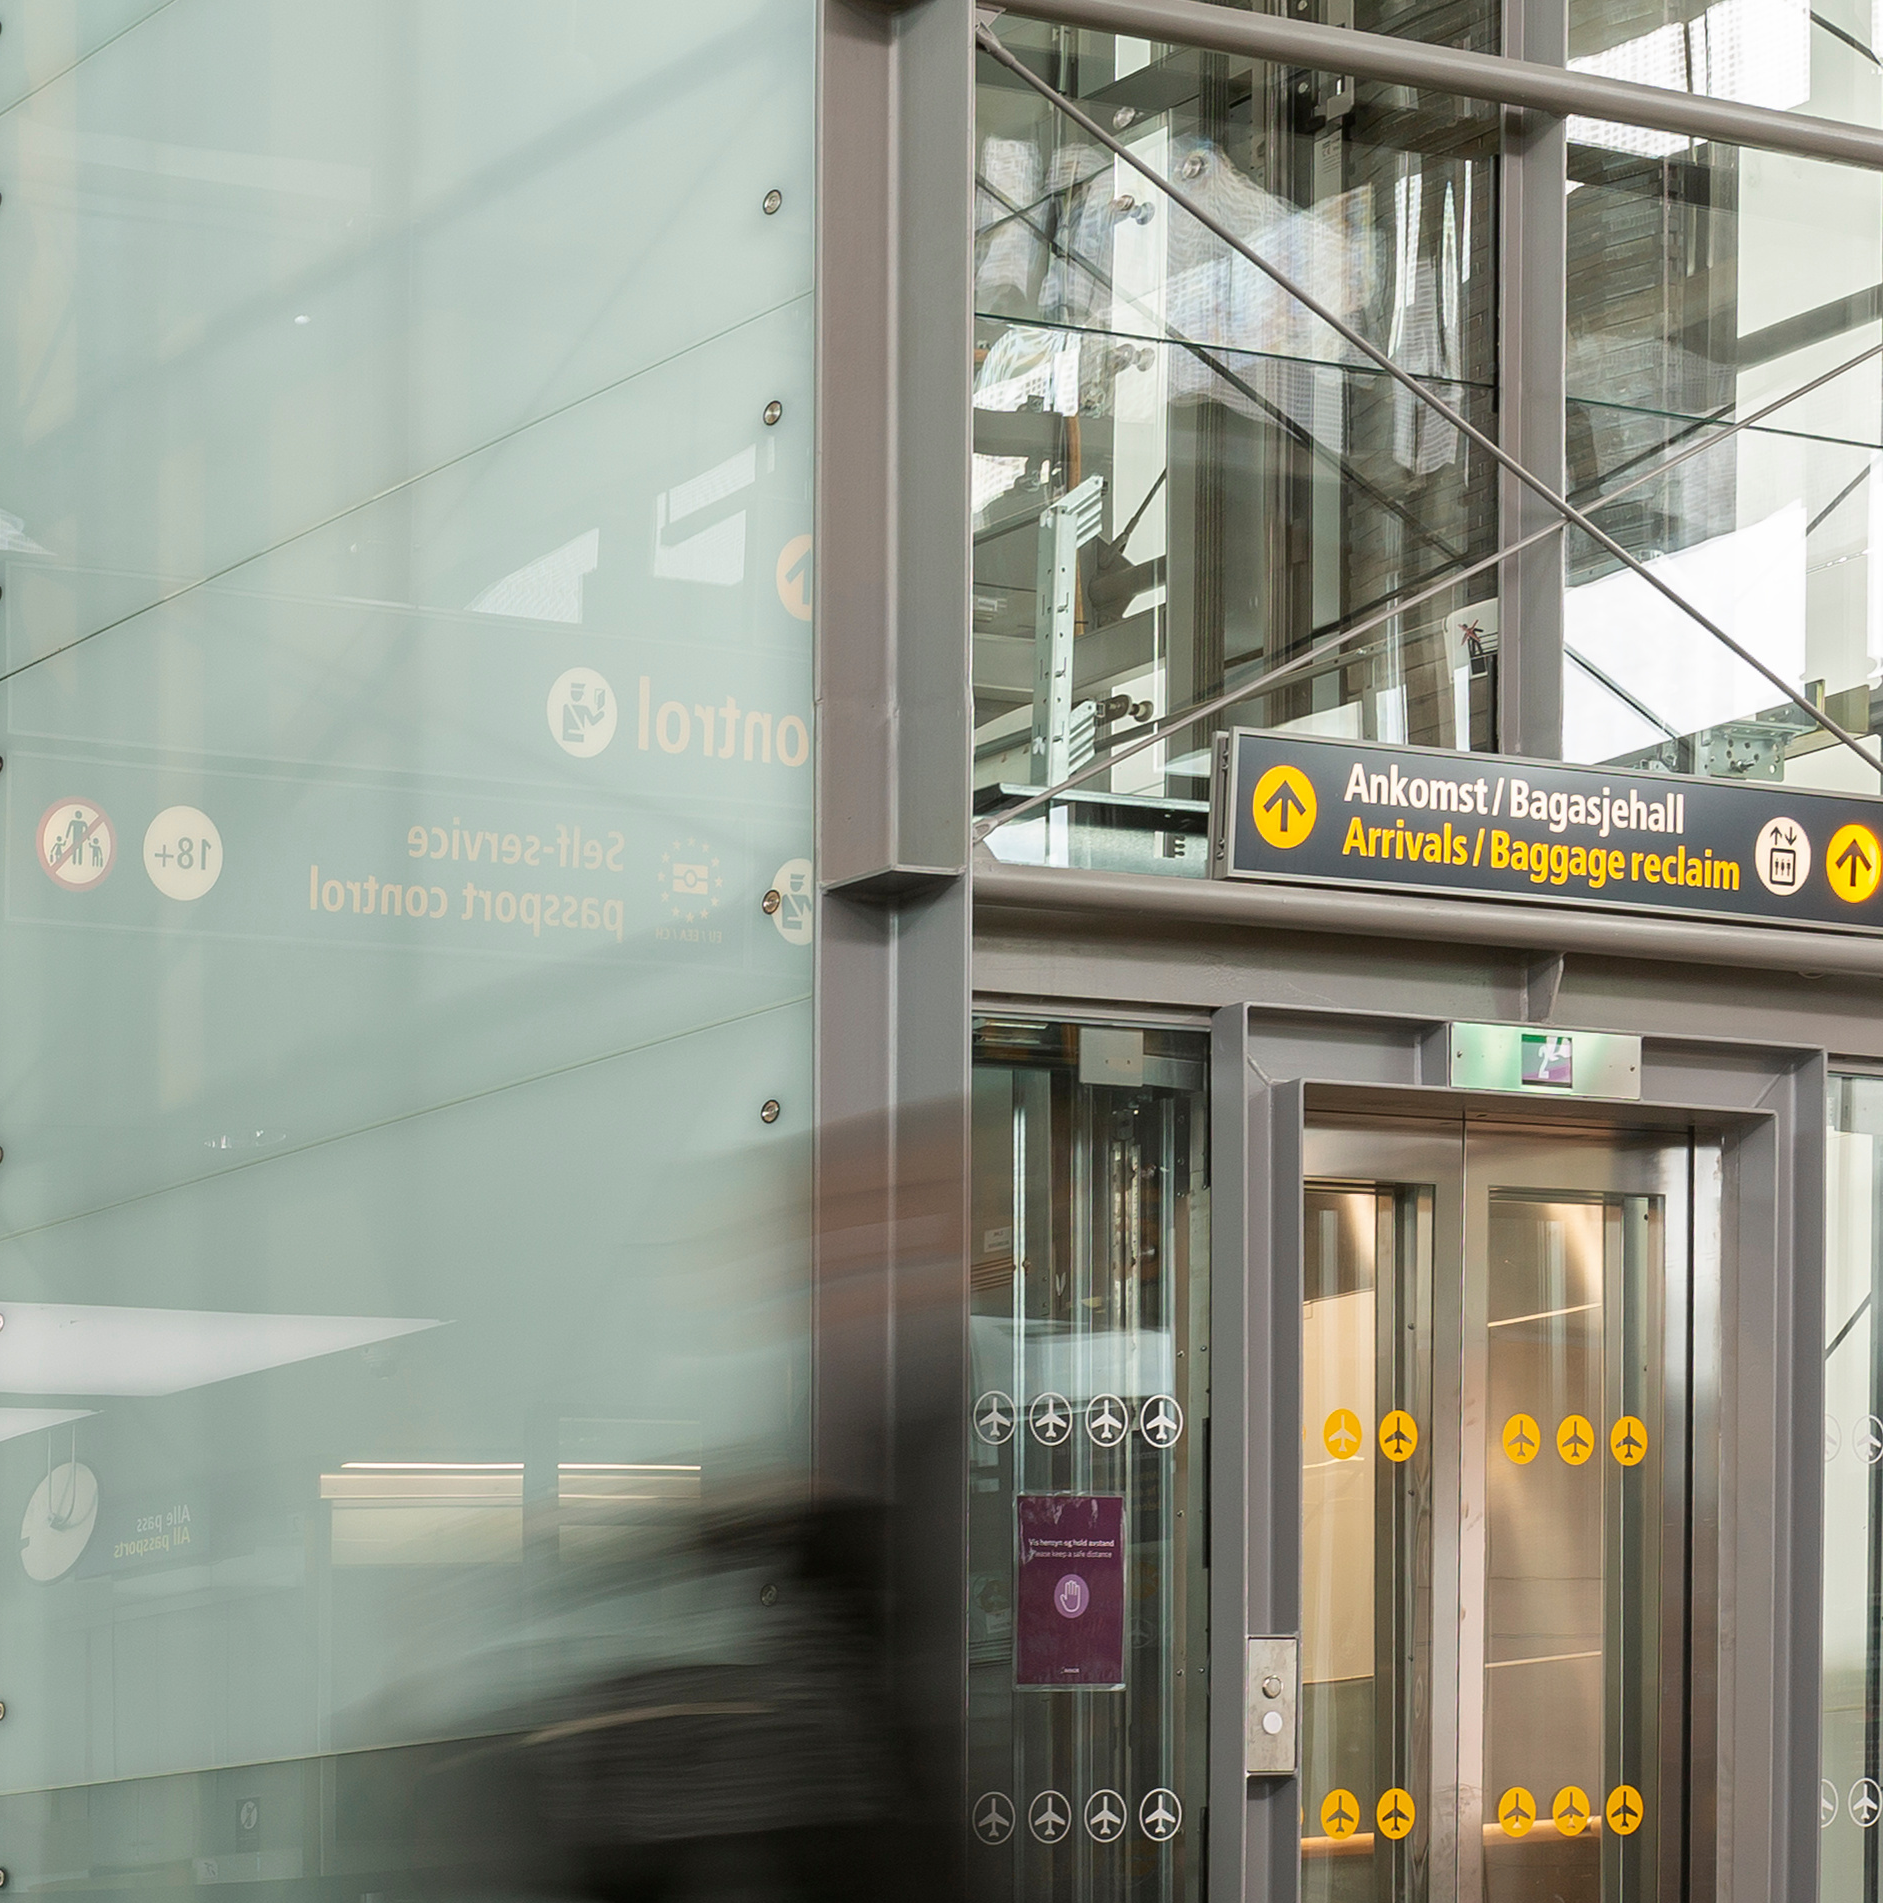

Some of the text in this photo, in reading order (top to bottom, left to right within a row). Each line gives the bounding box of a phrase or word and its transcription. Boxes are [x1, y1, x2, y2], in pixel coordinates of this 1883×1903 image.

[1343, 762, 1685, 838] Ankomst / Bagasjehall
[1342, 815, 1742, 891] Arrivals / Baggage reclaim
